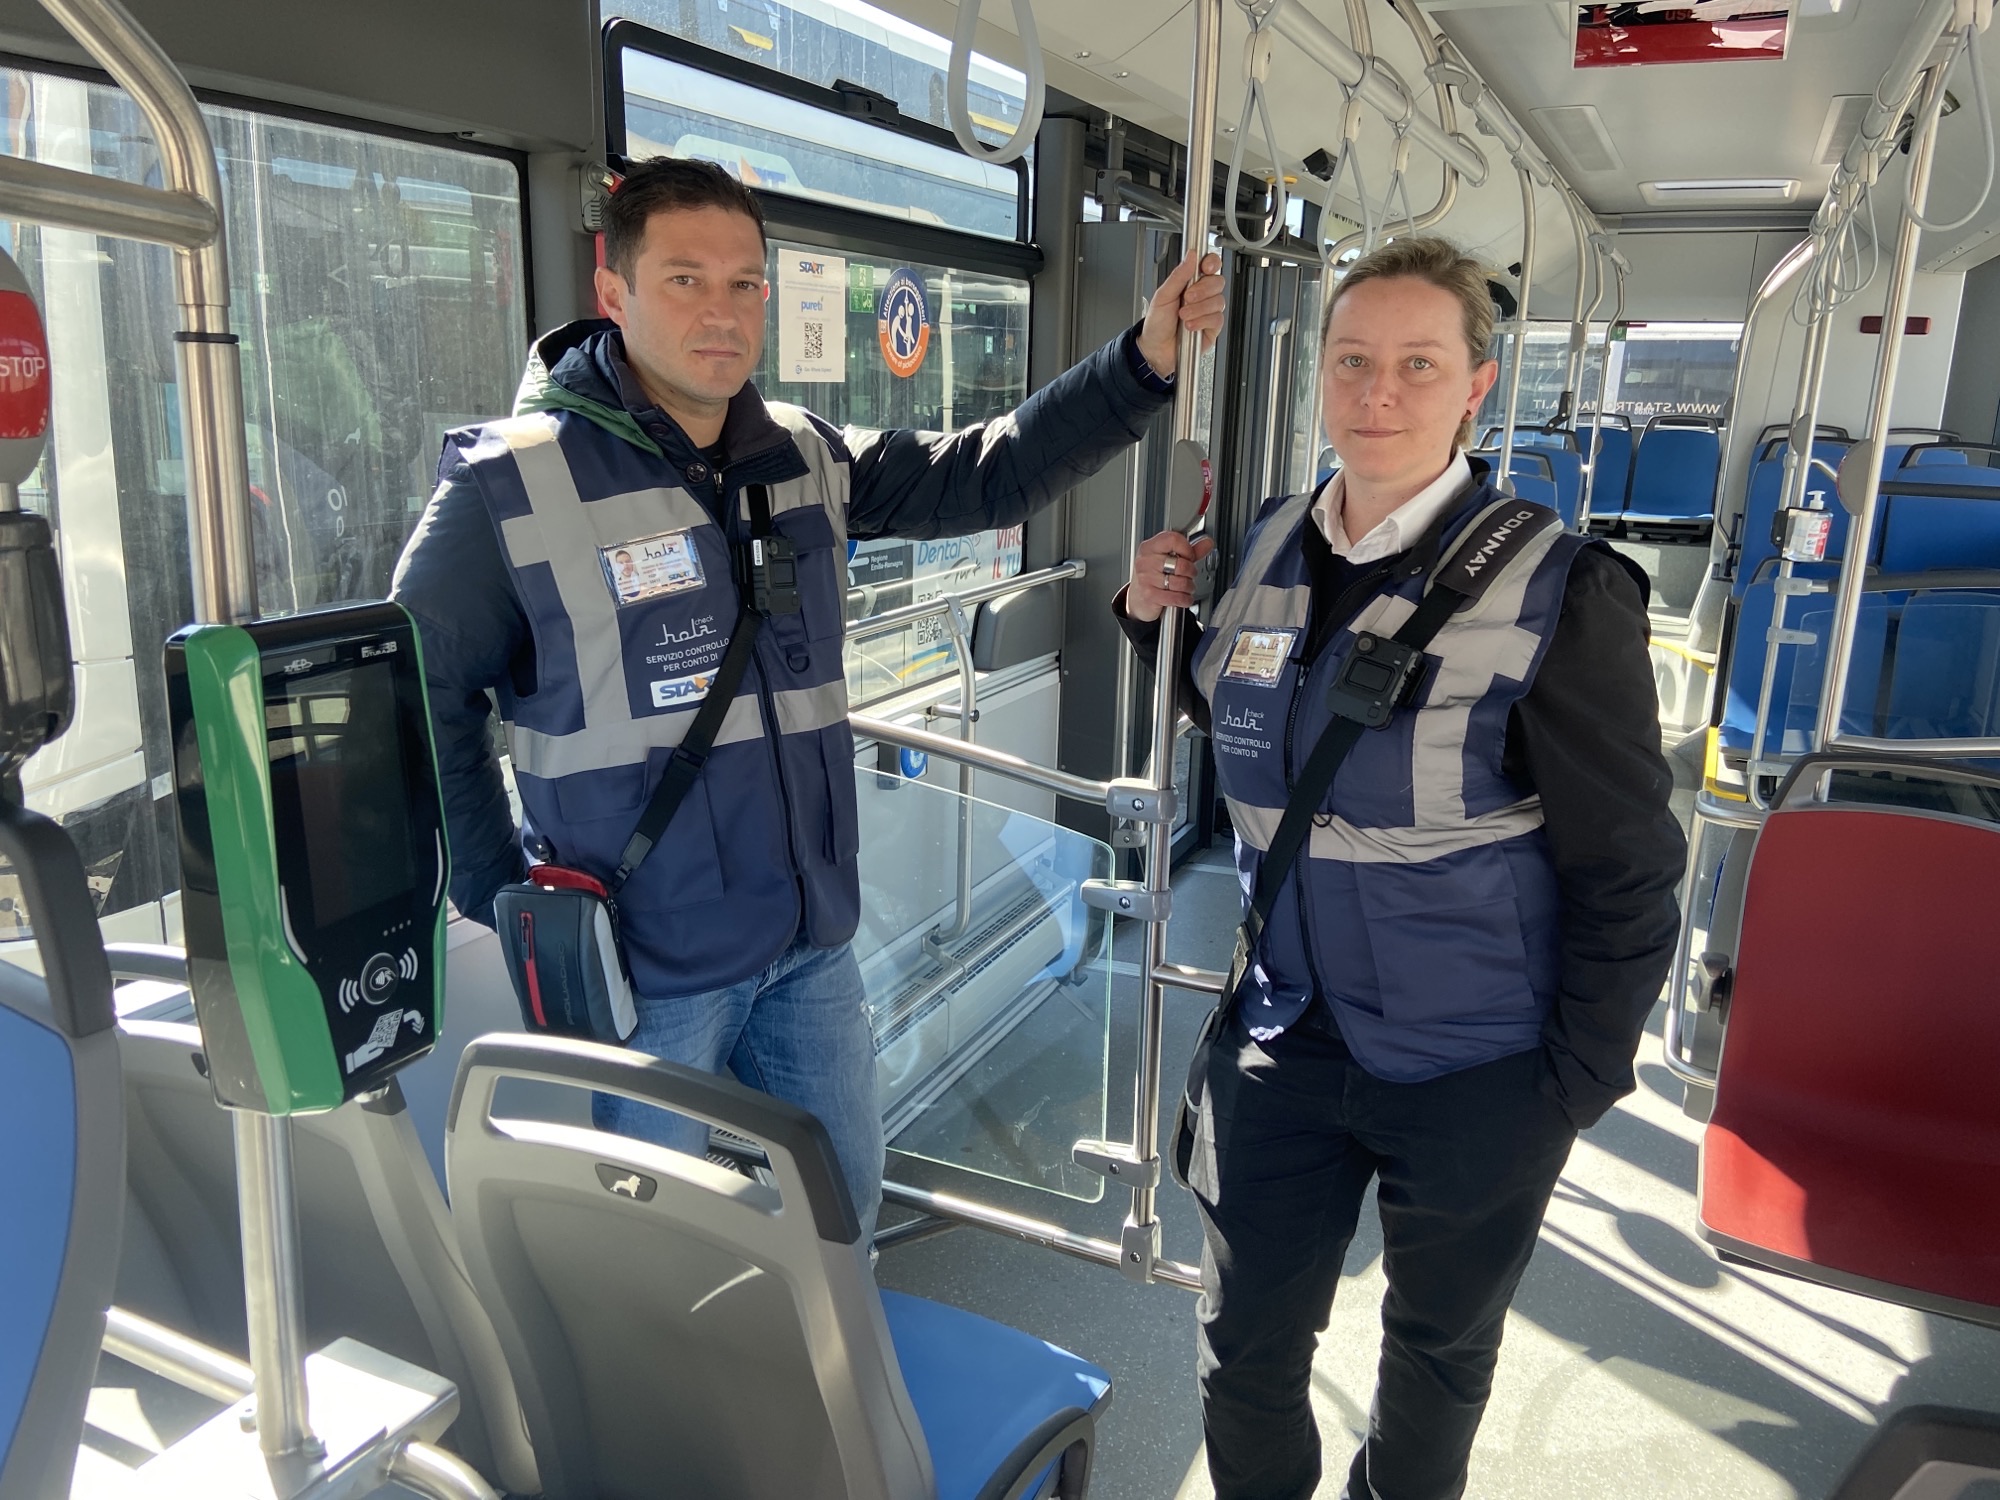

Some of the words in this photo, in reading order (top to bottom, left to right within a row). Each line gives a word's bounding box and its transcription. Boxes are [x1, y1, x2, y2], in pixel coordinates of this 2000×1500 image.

[799, 261, 825, 275] START
[0, 356, 46, 377] STOP
[917, 536, 961, 567] Dental
[1464, 510, 1535, 578] DONNAY
[870, 554, 889, 564] Regione
[992, 557, 1002, 580] IL
[694, 615, 714, 626] check
[645, 651, 684, 664] SERVIZIO
[685, 637, 730, 657] CONTROLLO
[663, 662, 681, 673] PER
[681, 655, 709, 669] CONTO
[709, 652, 719, 661] DI
[1247, 707, 1265, 719] check
[1215, 731, 1234, 744] SERVIZIO
[1233, 736, 1271, 750] CONTROLLO
[1221, 744, 1231, 754] PER
[1231, 746, 1251, 757] CONTO
[1250, 749, 1259, 759] DI
[559, 942, 575, 1026] PIQUADRO
